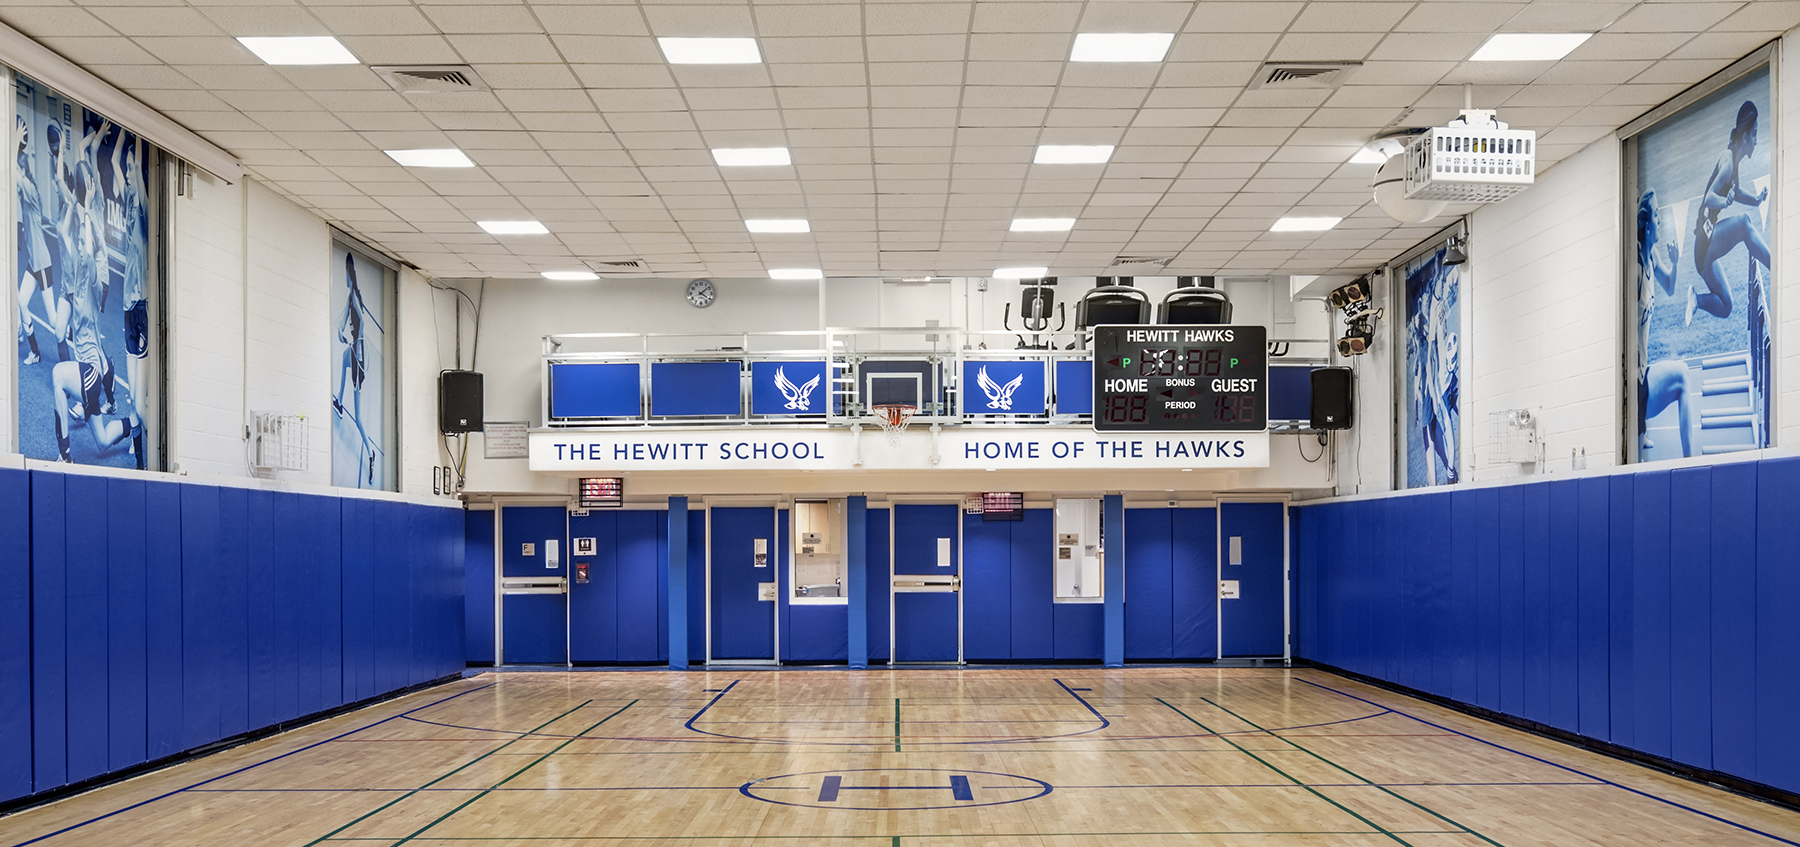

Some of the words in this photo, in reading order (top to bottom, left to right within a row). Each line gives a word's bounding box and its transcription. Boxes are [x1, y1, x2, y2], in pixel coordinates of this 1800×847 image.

[1126, 330, 1180, 342] HEWITT
[1184, 329, 1235, 343] HAWKS
[1122, 357, 1131, 368] P
[1230, 357, 1239, 368] P
[1104, 378, 1148, 392] HOME
[1165, 378, 1196, 387] BONUS
[1211, 378, 1258, 392] GUEST
[1164, 401, 1196, 410] PERIOD
[554, 443, 601, 460] THE
[614, 443, 708, 460] HEWITT
[719, 442, 825, 460] SCHOOL
[964, 441, 1040, 459] HOME
[1051, 441, 1085, 459] OF
[1096, 441, 1144, 458] THE
[1155, 440, 1246, 458] HAWKS
